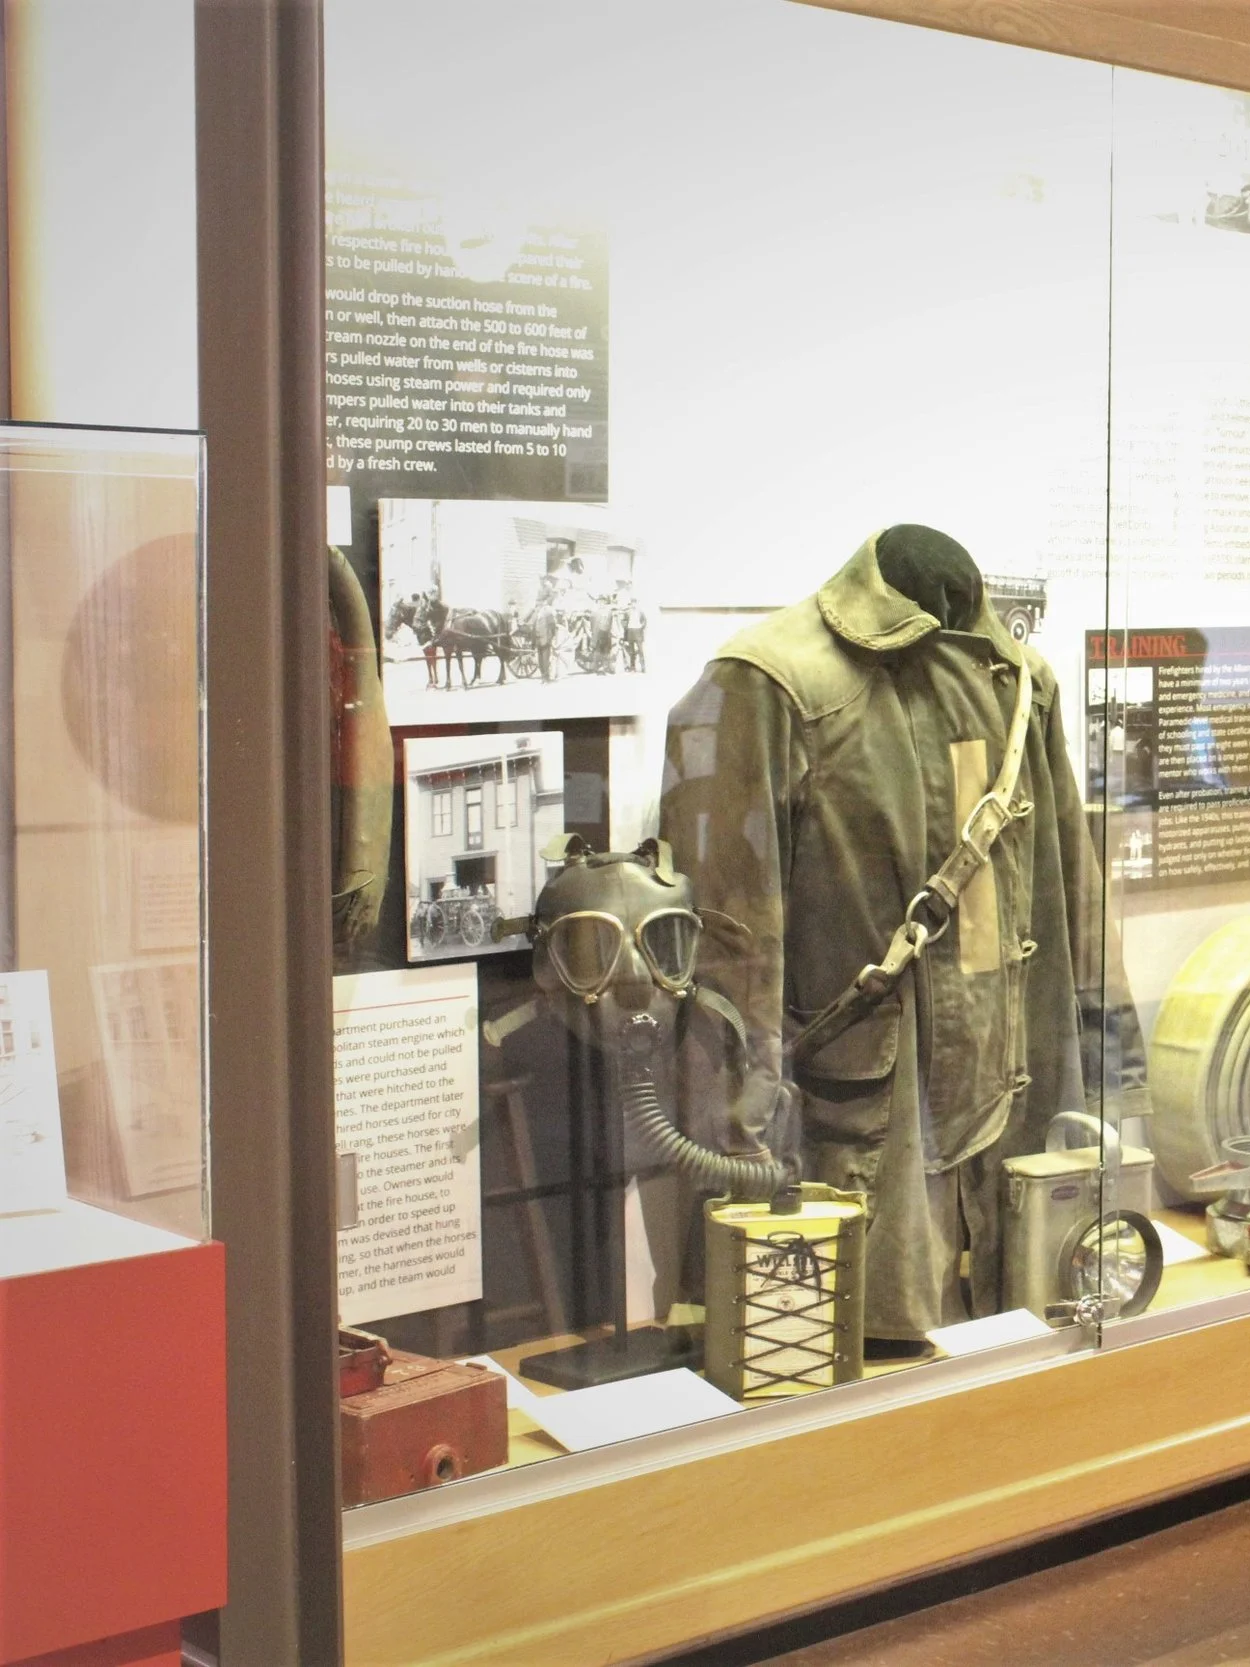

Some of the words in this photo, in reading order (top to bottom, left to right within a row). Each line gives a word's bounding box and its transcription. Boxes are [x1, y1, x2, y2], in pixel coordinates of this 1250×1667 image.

[332, 234, 397, 251] respective
[401, 239, 422, 254] fire
[354, 255, 370, 270] be
[373, 259, 413, 275] pulled
[416, 260, 432, 278] by
[325, 287, 364, 301] would
[368, 289, 398, 308] drop
[401, 292, 423, 307] the
[425, 295, 471, 311] suction
[473, 298, 503, 314] hose
[505, 300, 535, 316] from
[537, 303, 557, 318] the
[354, 310, 384, 326] well,
[386, 312, 416, 327] then
[419, 316, 458, 330] attach
[461, 318, 481, 331] the
[484, 319, 506, 334] 500
[524, 322, 547, 337] 600
[548, 324, 572, 339] feet
[366, 332, 407, 347] nozzle
[409, 337, 426, 349] on
[429, 336, 450, 350] the
[452, 337, 476, 352] end
[480, 339, 493, 353] of
[494, 340, 515, 355] the
[517, 342, 538, 356] fire
[540, 343, 569, 358] hose
[570, 347, 594, 360] was
[340, 351, 380, 367] pulled
[384, 356, 420, 368] water
[423, 355, 454, 370] from
[457, 359, 488, 373] wells
[506, 362, 552, 377] cisterns
[554, 364, 578, 379] into
[325, 371, 363, 386] hoses
[366, 373, 400, 391] using
[403, 377, 442, 390] steam
[445, 380, 483, 395] power
[487, 381, 510, 394] and
[512, 383, 564, 399] required
[566, 385, 591, 403] only
[369, 394, 409, 411] pulled
[411, 399, 447, 410] water
[450, 398, 475, 413] into
[477, 400, 506, 414] their
[508, 402, 544, 416] tanks
[545, 404, 567, 418] and
[345, 415, 404, 433] requiring
[406, 416, 423, 430] 20
[442, 418, 457, 432] 30
[460, 421, 487, 434] men
[490, 422, 504, 434] to
[506, 423, 560, 440] manually
[562, 424, 592, 439] hand
[336, 433, 372, 448] these
[375, 437, 413, 453] pump
[416, 440, 452, 452] crews
[454, 439, 491, 453] lasted
[494, 440, 524, 454] from
[551, 444, 567, 457] 10
[337, 455, 354, 472] by
[367, 456, 400, 470] fresh
[403, 460, 438, 472] crew.
[1090, 636, 1186, 659] TRAINING
[379, 1015, 431, 1032] purchased
[434, 1016, 446, 1024] an
[368, 1038, 398, 1048] steam
[401, 1033, 434, 1045] engine
[437, 1027, 465, 1039] which
[346, 1056, 365, 1068] and
[368, 1052, 395, 1064] could
[398, 1051, 414, 1060] not
[417, 1048, 429, 1058] be
[432, 1043, 462, 1059] pulled
[345, 1073, 371, 1084] were
[373, 1063, 426, 1082] purchased
[428, 1060, 447, 1072] and
[336, 1091, 356, 1102] that
[359, 1087, 384, 1098] were
[387, 1080, 423, 1093] hitched
[438, 1076, 455, 1087] the
[360, 1103, 379, 1113] The
[381, 1095, 440, 1111] department
[442, 1092, 464, 1102] later
[336, 1121, 363, 1133] hired
[365, 1117, 399, 1129] horses
[401, 1112, 425, 1124] used
[428, 1110, 442, 1119] for
[445, 1108, 461, 1118] city
[377, 1132, 404, 1144] these
[407, 1127, 440, 1139] horses
[442, 1123, 467, 1134] were
[373, 1147, 411, 1161] houses.
[414, 1144, 432, 1153] The
[435, 1140, 454, 1151] first
[366, 1168, 383, 1178] the
[385, 1161, 425, 1175] steamer
[428, 1156, 447, 1168] and
[360, 1185, 381, 1195] use.
[383, 1178, 422, 1191] Owners
[424, 1169, 454, 1184] would
[367, 1200, 383, 1210] the
[386, 1196, 403, 1206] fire
[405, 1191, 437, 1203] house,
[368, 1213, 395, 1226] order
[411, 1205, 440, 1220] speed
[443, 1203, 456, 1214] up
[351, 1234, 371, 1245] was
[373, 1225, 411, 1241] devised
[413, 1222, 433, 1234] that
[435, 1218, 461, 1229] hung
[373, 1246, 394, 1257] that
[396, 1241, 423, 1253] when
[426, 1236, 441, 1247] the
[444, 1231, 476, 1244] horses
[364, 1264, 380, 1275] the
[383, 1255, 433, 1270] harnesses
[435, 1247, 465, 1260] would
[357, 1280, 377, 1293] and
[379, 1276, 396, 1288] the
[398, 1272, 423, 1284] team
[426, 1263, 456, 1278] would
